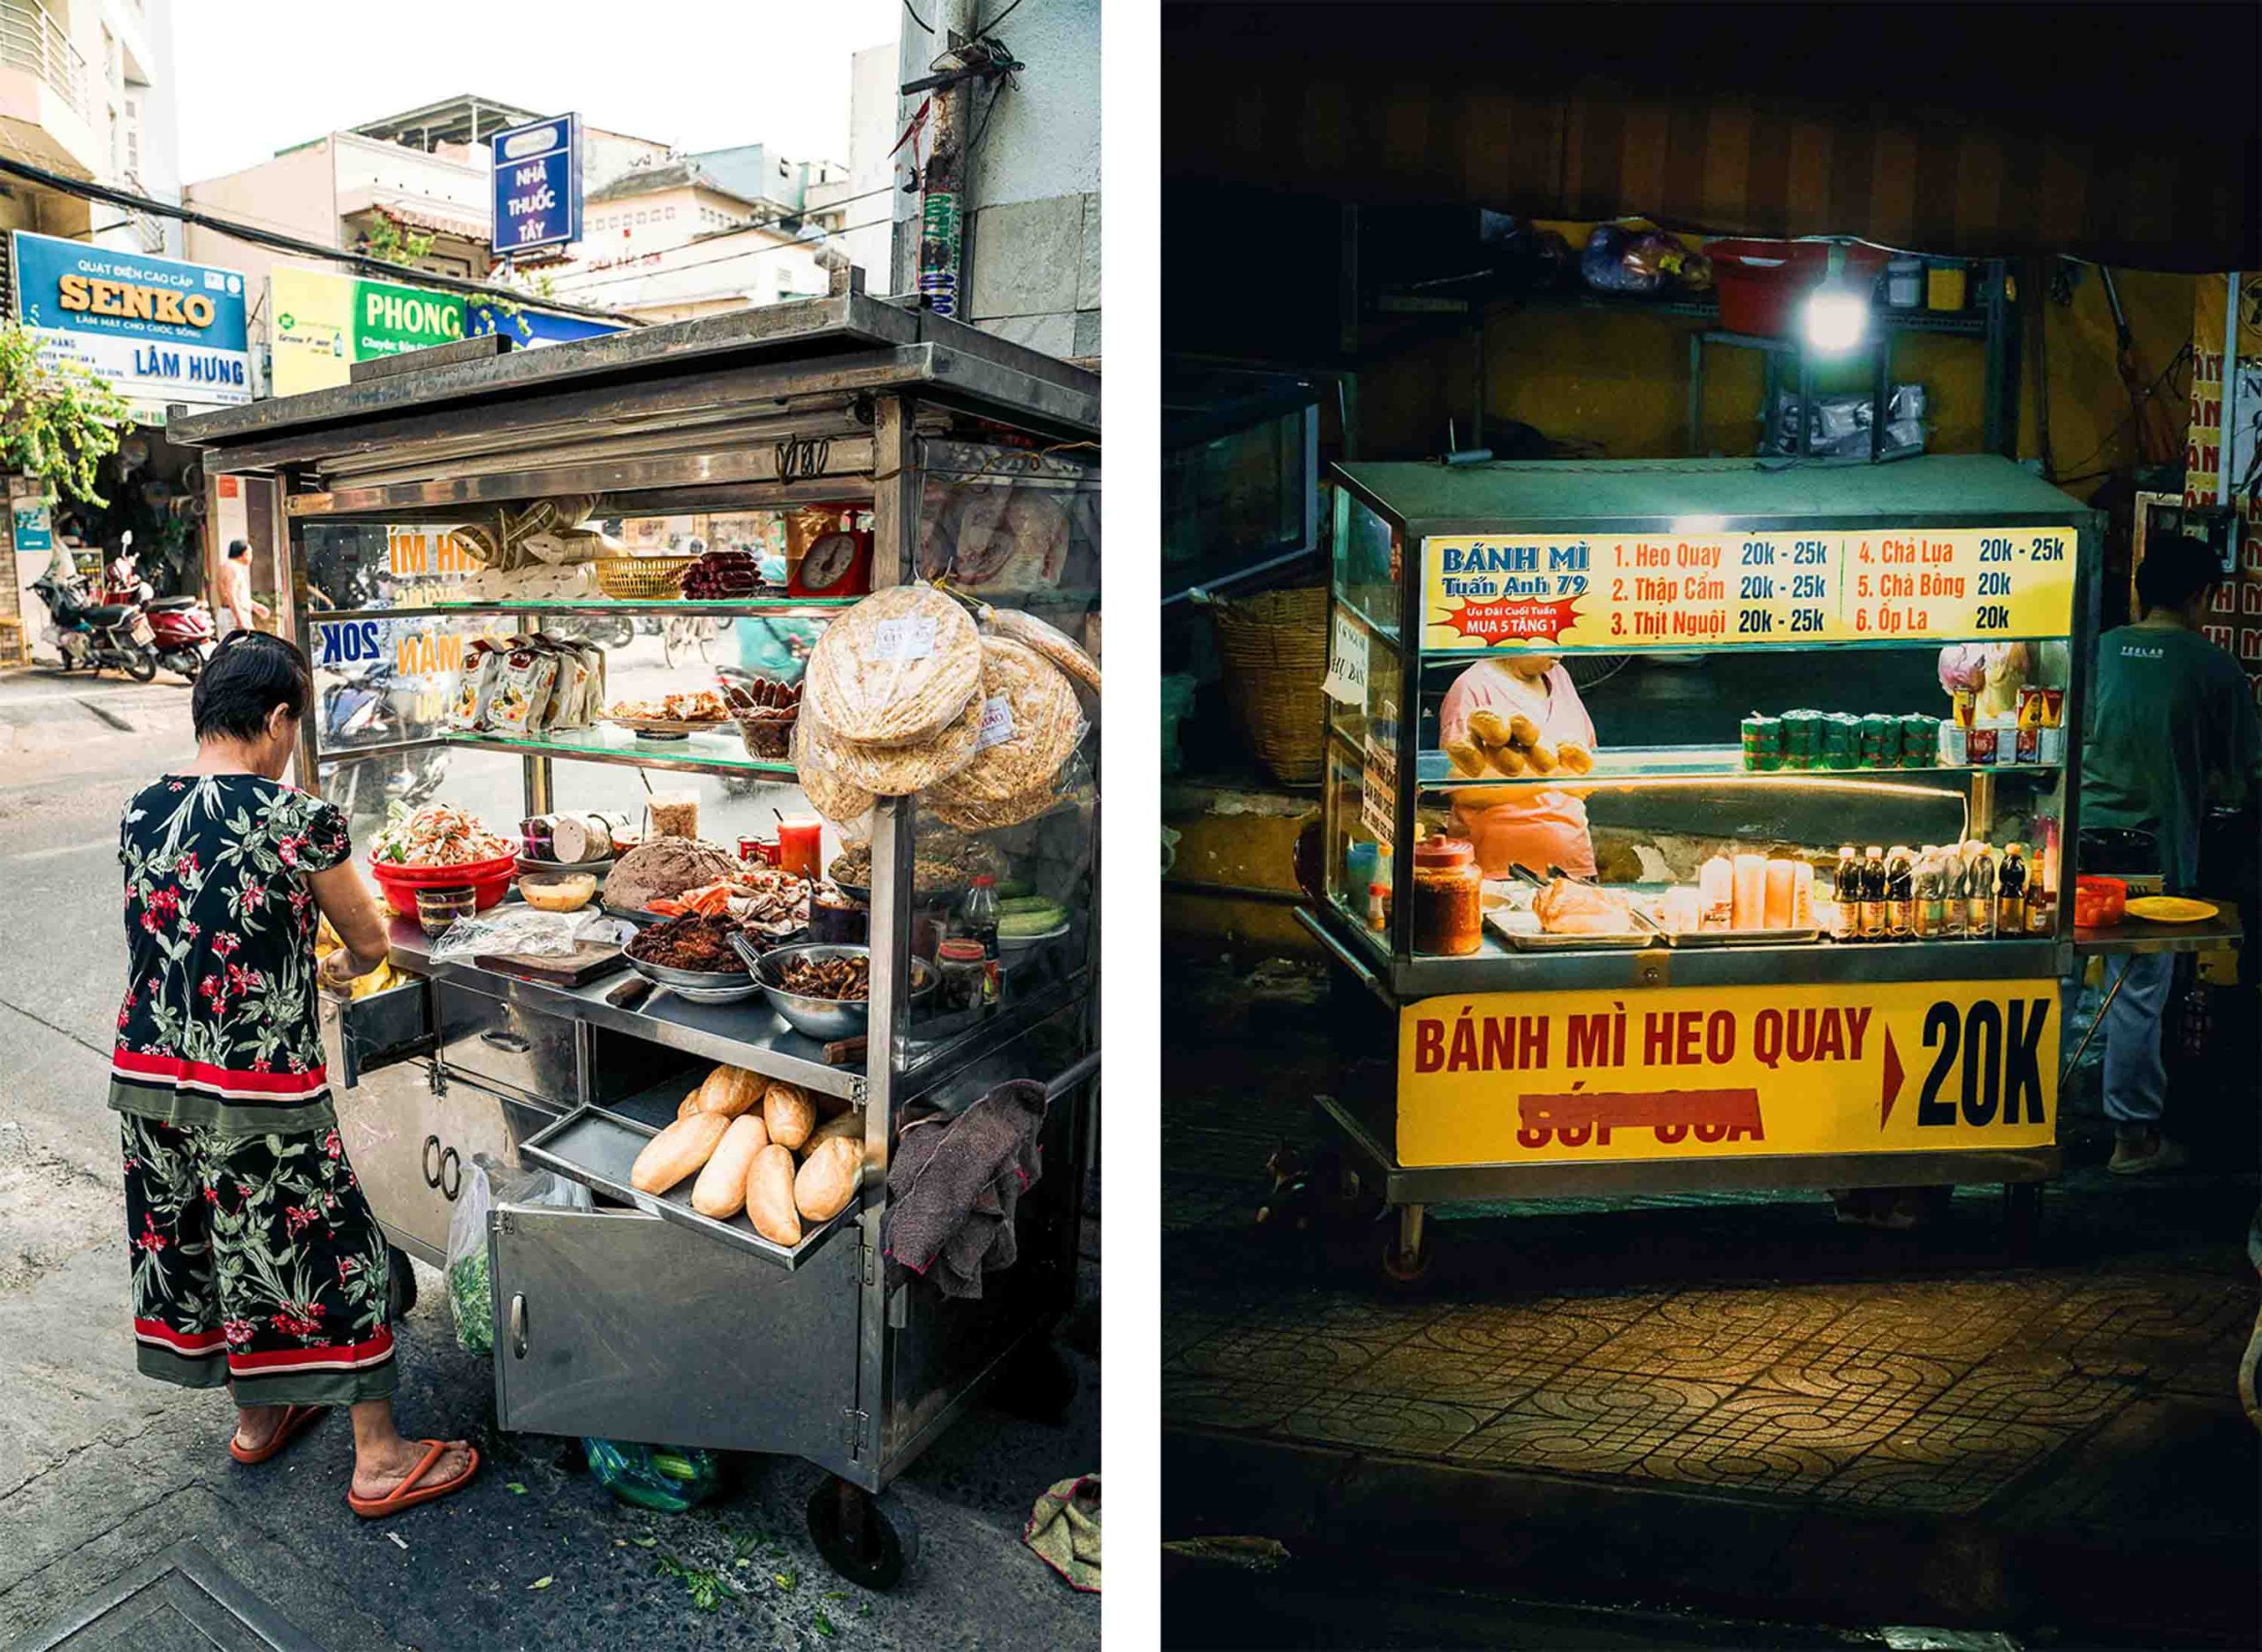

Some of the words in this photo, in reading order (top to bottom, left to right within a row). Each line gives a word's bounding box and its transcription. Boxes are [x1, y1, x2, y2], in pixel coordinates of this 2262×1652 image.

[508, 184, 556, 216] THUỐC
[518, 219, 545, 242] TÂY
[59, 274, 215, 328] SENKO
[367, 293, 460, 337] PHONG
[188, 355, 244, 385] HƯNG
[1443, 542, 1539, 573] BÁNH
[1548, 541, 1590, 572] MÌ
[1614, 544, 1629, 567] 1.
[1636, 544, 1670, 567] Heo
[1678, 542, 1721, 568] Quay
[1742, 542, 1775, 565] 20k
[1794, 541, 1826, 565] 25k
[1859, 541, 1875, 564] 4.
[1881, 537, 1916, 564] Chả
[1921, 540, 1954, 568] Lụa
[1979, 539, 2013, 562] 20k
[2031, 538, 2064, 561] 25k
[1442, 576, 1498, 597] Tuấn
[1503, 576, 1550, 597] Anh
[1557, 575, 1589, 595] 79
[1612, 578, 1628, 601] 2.
[1636, 577, 1678, 606] Thập
[1684, 571, 1724, 600] Cẩm
[1740, 576, 1773, 599] 20k
[1792, 574, 1826, 598] 25k
[1857, 575, 1873, 598] 5.
[1920, 572, 1965, 599] Bông
[1977, 572, 2011, 595] 20k
[1467, 620, 1498, 633] MUA
[1500, 620, 1509, 633] 5
[1511, 618, 1547, 635] TẶNG
[1551, 619, 1557, 632] 1
[1611, 611, 1628, 636] 3.
[1635, 610, 1667, 639] Thịt
[1673, 609, 1726, 639] Nguội
[1739, 610, 1772, 633] 20k
[1790, 609, 1824, 632] 25k
[1856, 608, 1872, 631] 6.
[1879, 599, 1901, 633] Ốp
[1907, 607, 1928, 631] La
[1976, 606, 2009, 629] 20k
[1416, 1006, 1549, 1072] BÁNH
[1567, 1002, 1626, 1067] MÌ
[1644, 1010, 1735, 1065] HEO
[1754, 1008, 1871, 1067] QUAY
[1917, 998, 2052, 1127] 20K
